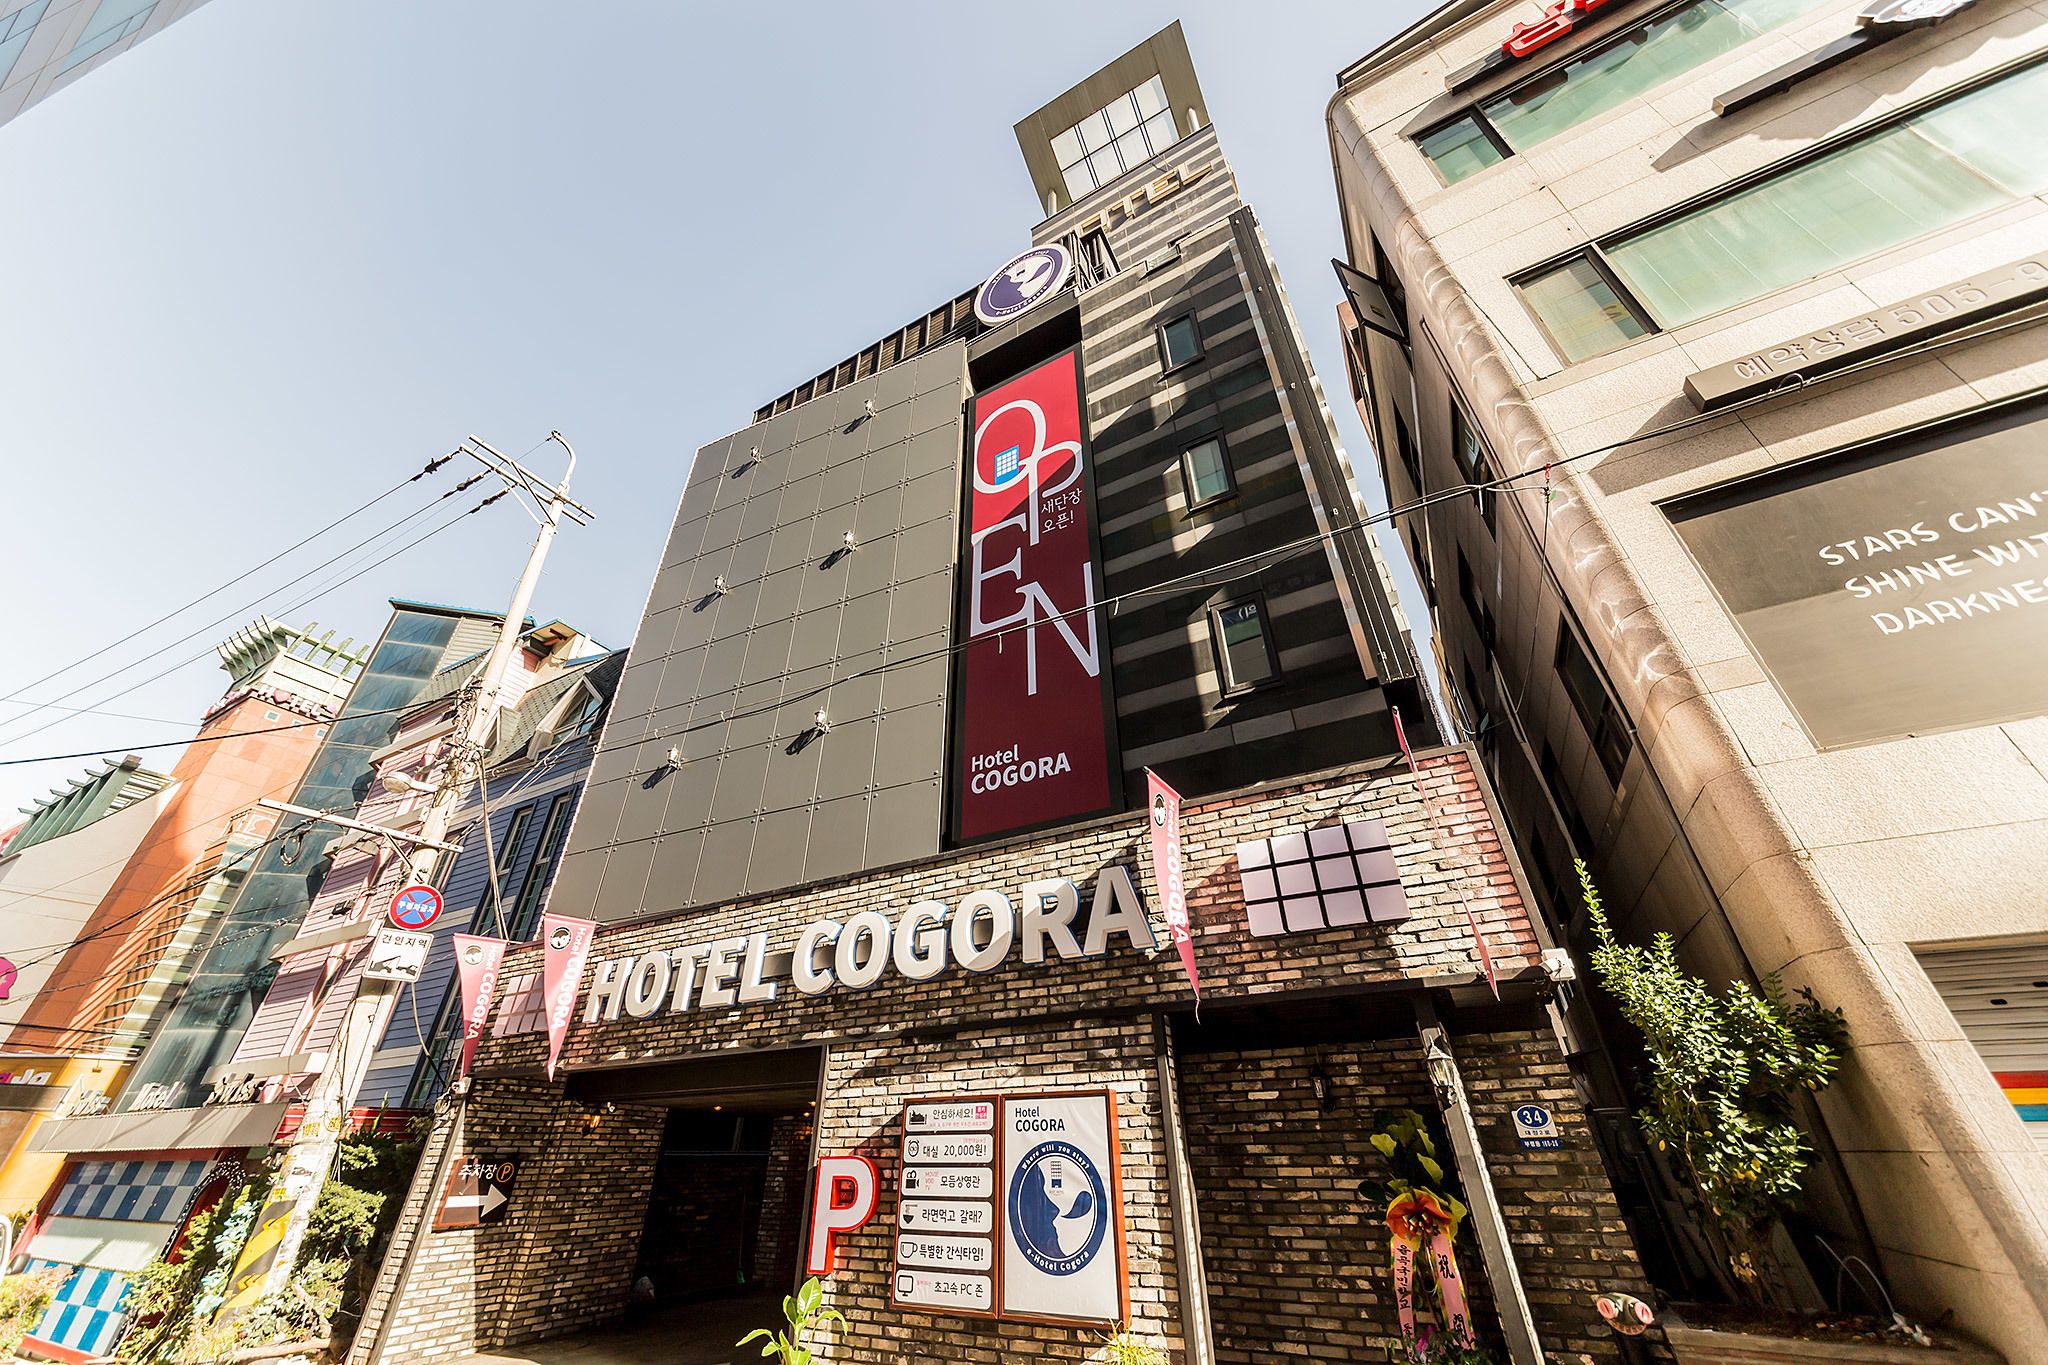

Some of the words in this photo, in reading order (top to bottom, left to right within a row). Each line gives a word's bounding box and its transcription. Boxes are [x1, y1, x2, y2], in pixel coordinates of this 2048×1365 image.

[1733, 317, 1887, 380] 예약상담
[1041, 487, 1083, 513] 새단장
[1041, 510, 1074, 534] 오픈!
[970, 399, 1102, 697] OPEN
[1818, 522, 1941, 567] STARS
[1844, 554, 1973, 599] SHINE
[970, 743, 1020, 773] Hotel
[970, 752, 1072, 795] COGORA
[1166, 840, 1190, 944] COGORA
[582, 932, 778, 1025] HOTEL
[791, 864, 1159, 996] COGORA
[465, 971, 496, 1040] COGORA
[550, 957, 584, 1031] COGORA
[932, 1107, 974, 1120] 안심하세요!
[1015, 1105, 1040, 1118] Hotel
[1522, 1110, 1543, 1125] 34
[1015, 1118, 1066, 1132] COGORA
[922, 1145, 940, 1159] 대실
[943, 1143, 987, 1158] 20,000원!
[1021, 1150, 1041, 1171] Where
[1041, 1143, 1055, 1153] will
[1058, 1145, 1071, 1155] you
[1073, 1150, 1091, 1170] stay?
[458, 1163, 498, 1181] 주차장
[940, 1175, 981, 1189] 모듬상영관
[806, 1155, 880, 1275] P
[921, 1208, 956, 1223] 라면먹고
[960, 1209, 983, 1224] 갈래?
[919, 1243, 944, 1260] 특별한
[946, 1245, 984, 1262] 간식타임!
[1026, 1247, 1058, 1272] e-Hotel
[1060, 1250, 1090, 1272] Cogora
[934, 1281, 958, 1296] 초고속
[960, 1283, 972, 1296] PC
[974, 1283, 984, 1298] 존
